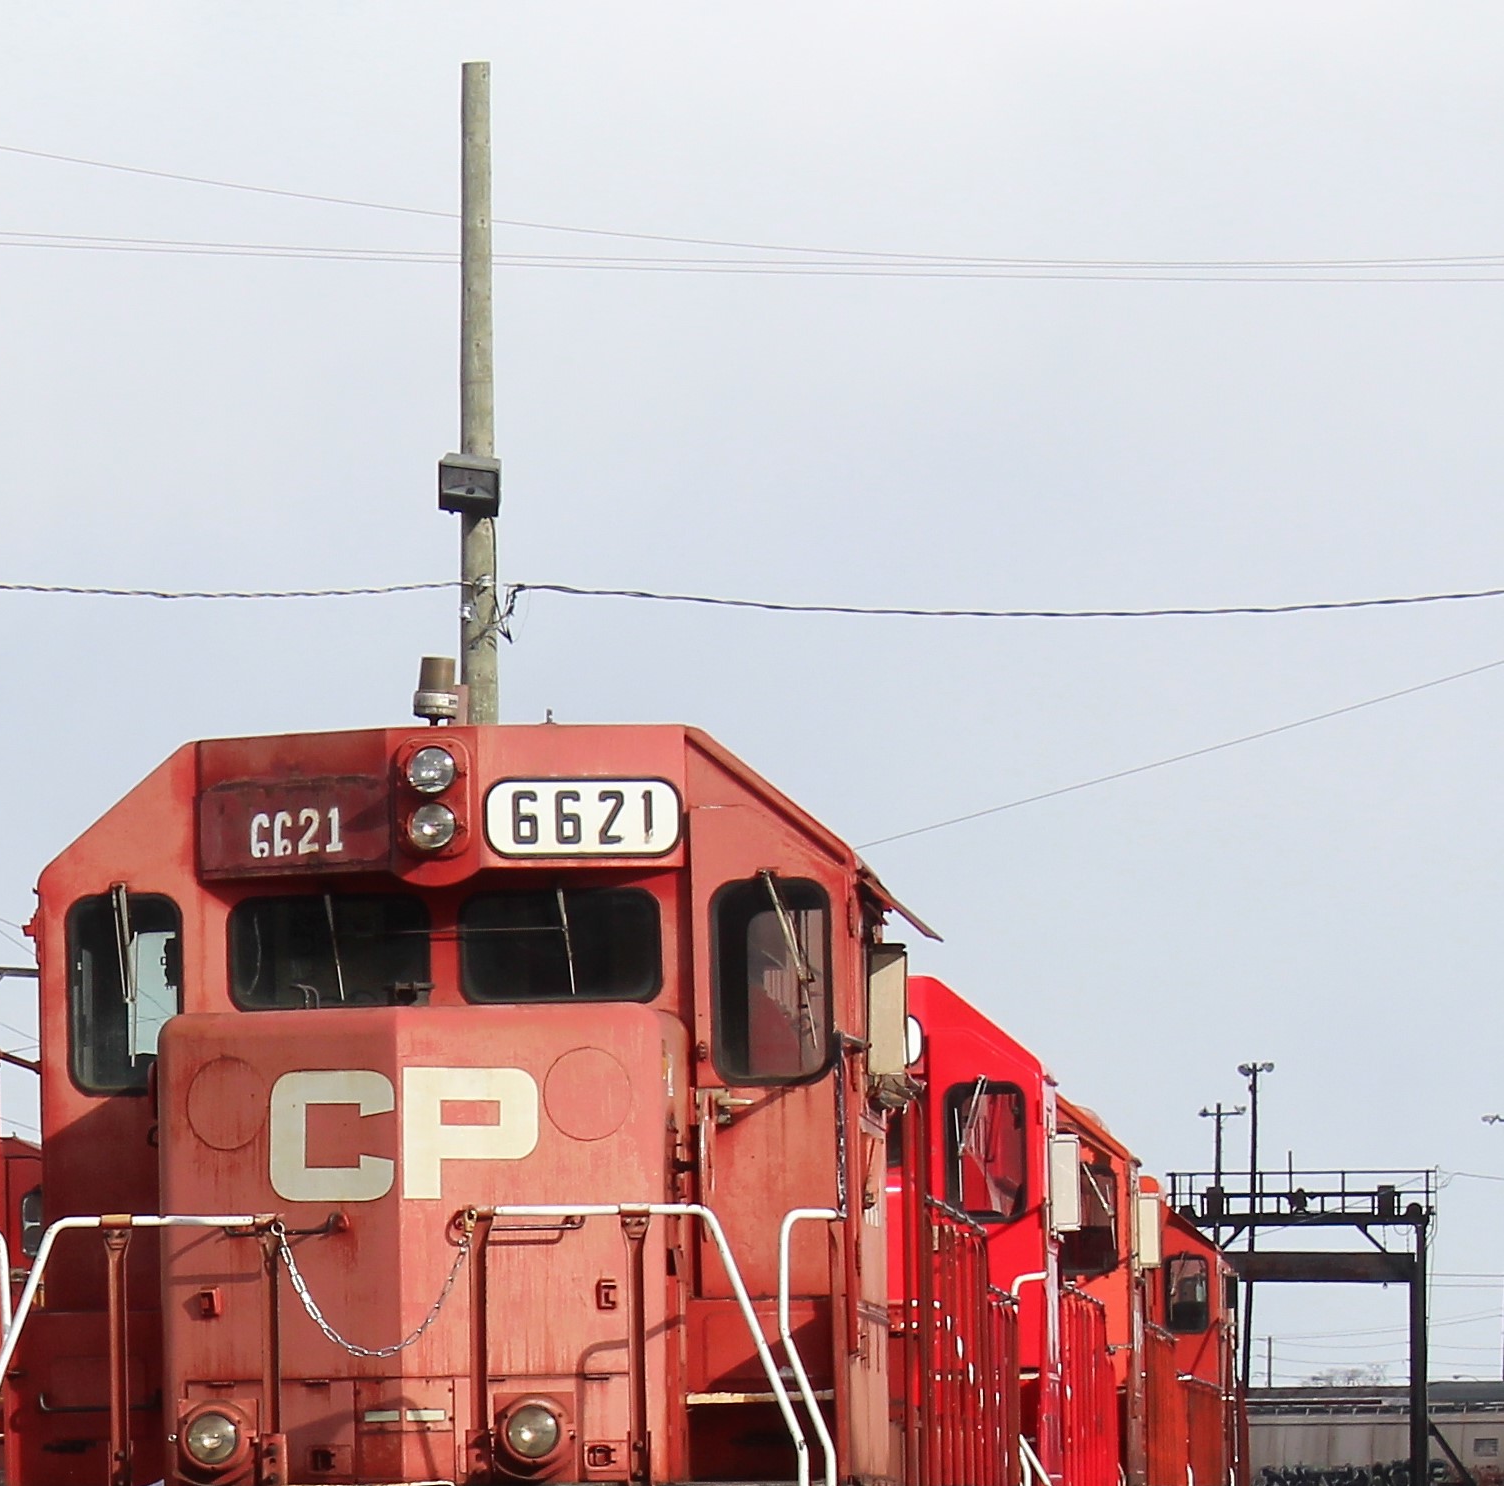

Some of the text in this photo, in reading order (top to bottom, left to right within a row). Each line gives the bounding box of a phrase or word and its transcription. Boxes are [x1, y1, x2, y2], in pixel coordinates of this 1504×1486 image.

[250, 807, 343, 859] 6621
[512, 790, 654, 846] 6621
[269, 1067, 539, 1202] CP
